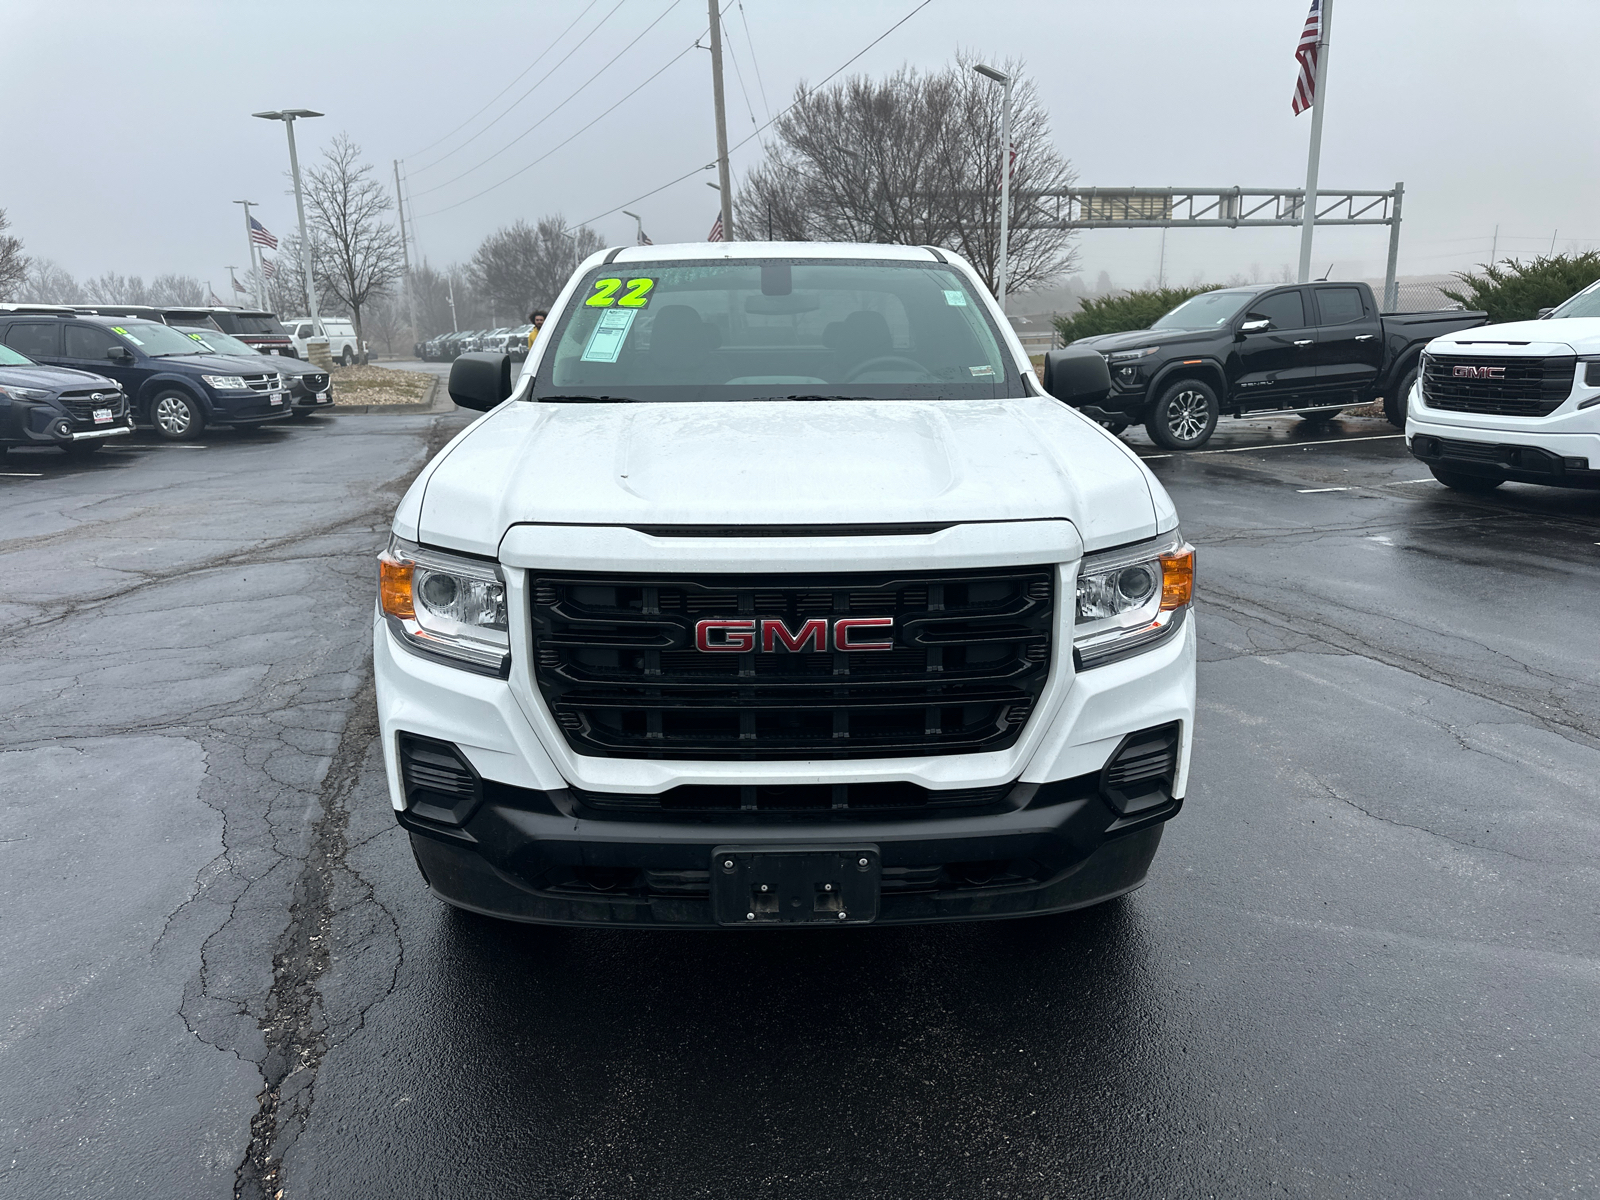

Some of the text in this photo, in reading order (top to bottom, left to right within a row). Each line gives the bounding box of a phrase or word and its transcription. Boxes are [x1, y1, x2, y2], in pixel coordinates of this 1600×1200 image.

[585, 278, 655, 307] 22
[1452, 365, 1506, 380] GMC
[695, 617, 894, 653] GMC
